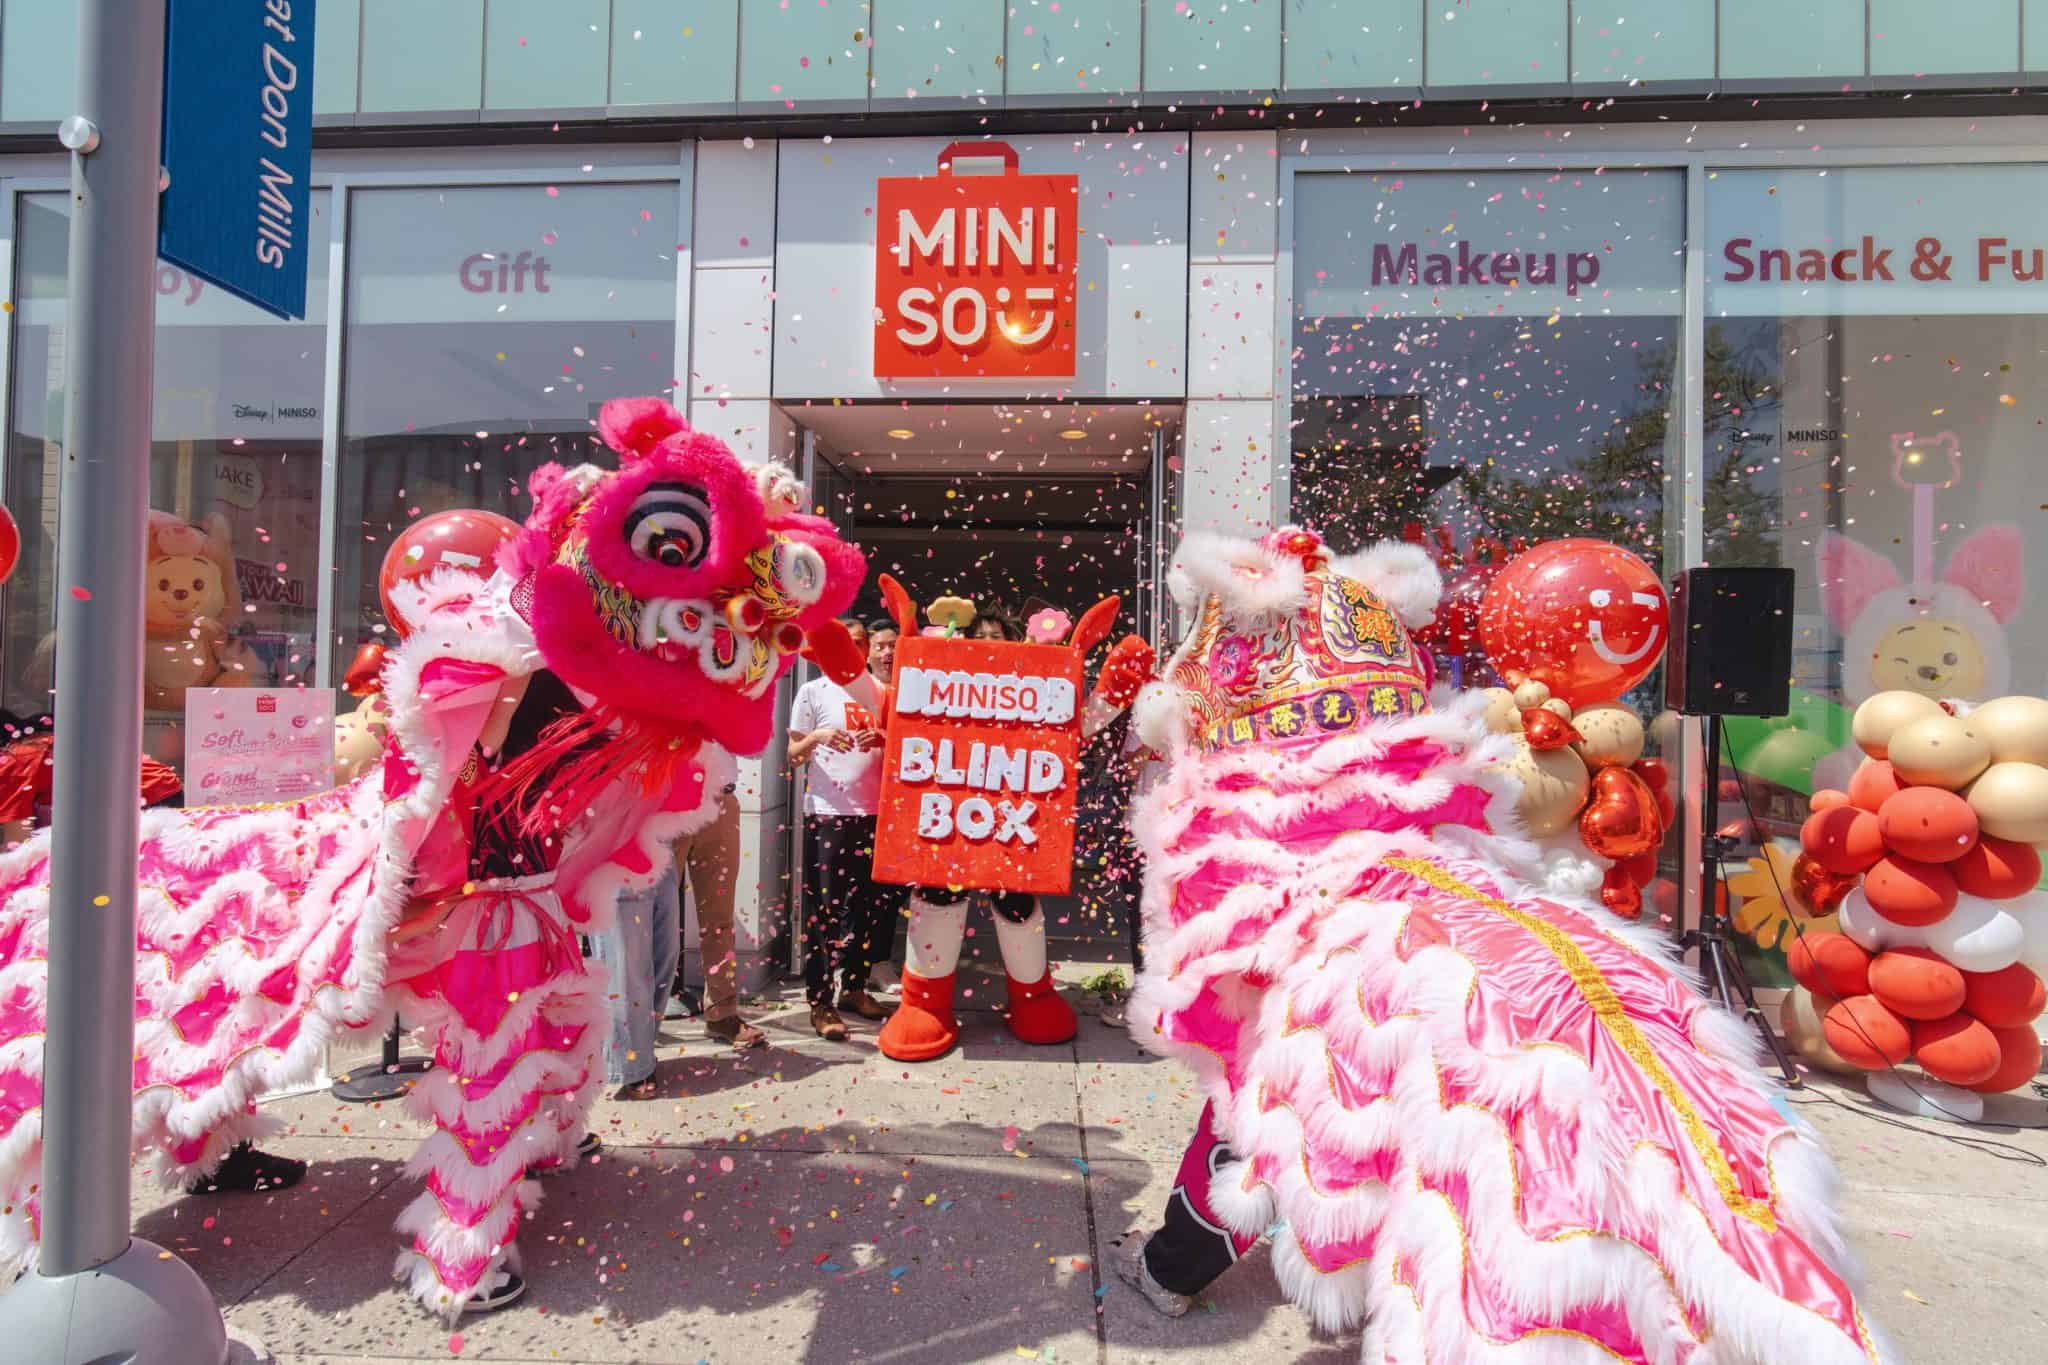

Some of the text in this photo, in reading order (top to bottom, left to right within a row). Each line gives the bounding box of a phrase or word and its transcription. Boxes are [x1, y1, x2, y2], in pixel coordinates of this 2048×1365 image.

[256, 0, 297, 269] at Don Mills
[898, 207, 1056, 267] MINI
[1723, 236, 1896, 283] Snack
[1909, 237, 1953, 283] &
[458, 250, 552, 294] Gift
[1371, 240, 1601, 297] Makeup
[1786, 429, 1839, 442] MINISO
[215, 463, 256, 488] AKE
[900, 737, 1064, 793] BLIND
[918, 793, 1039, 845] BOX
